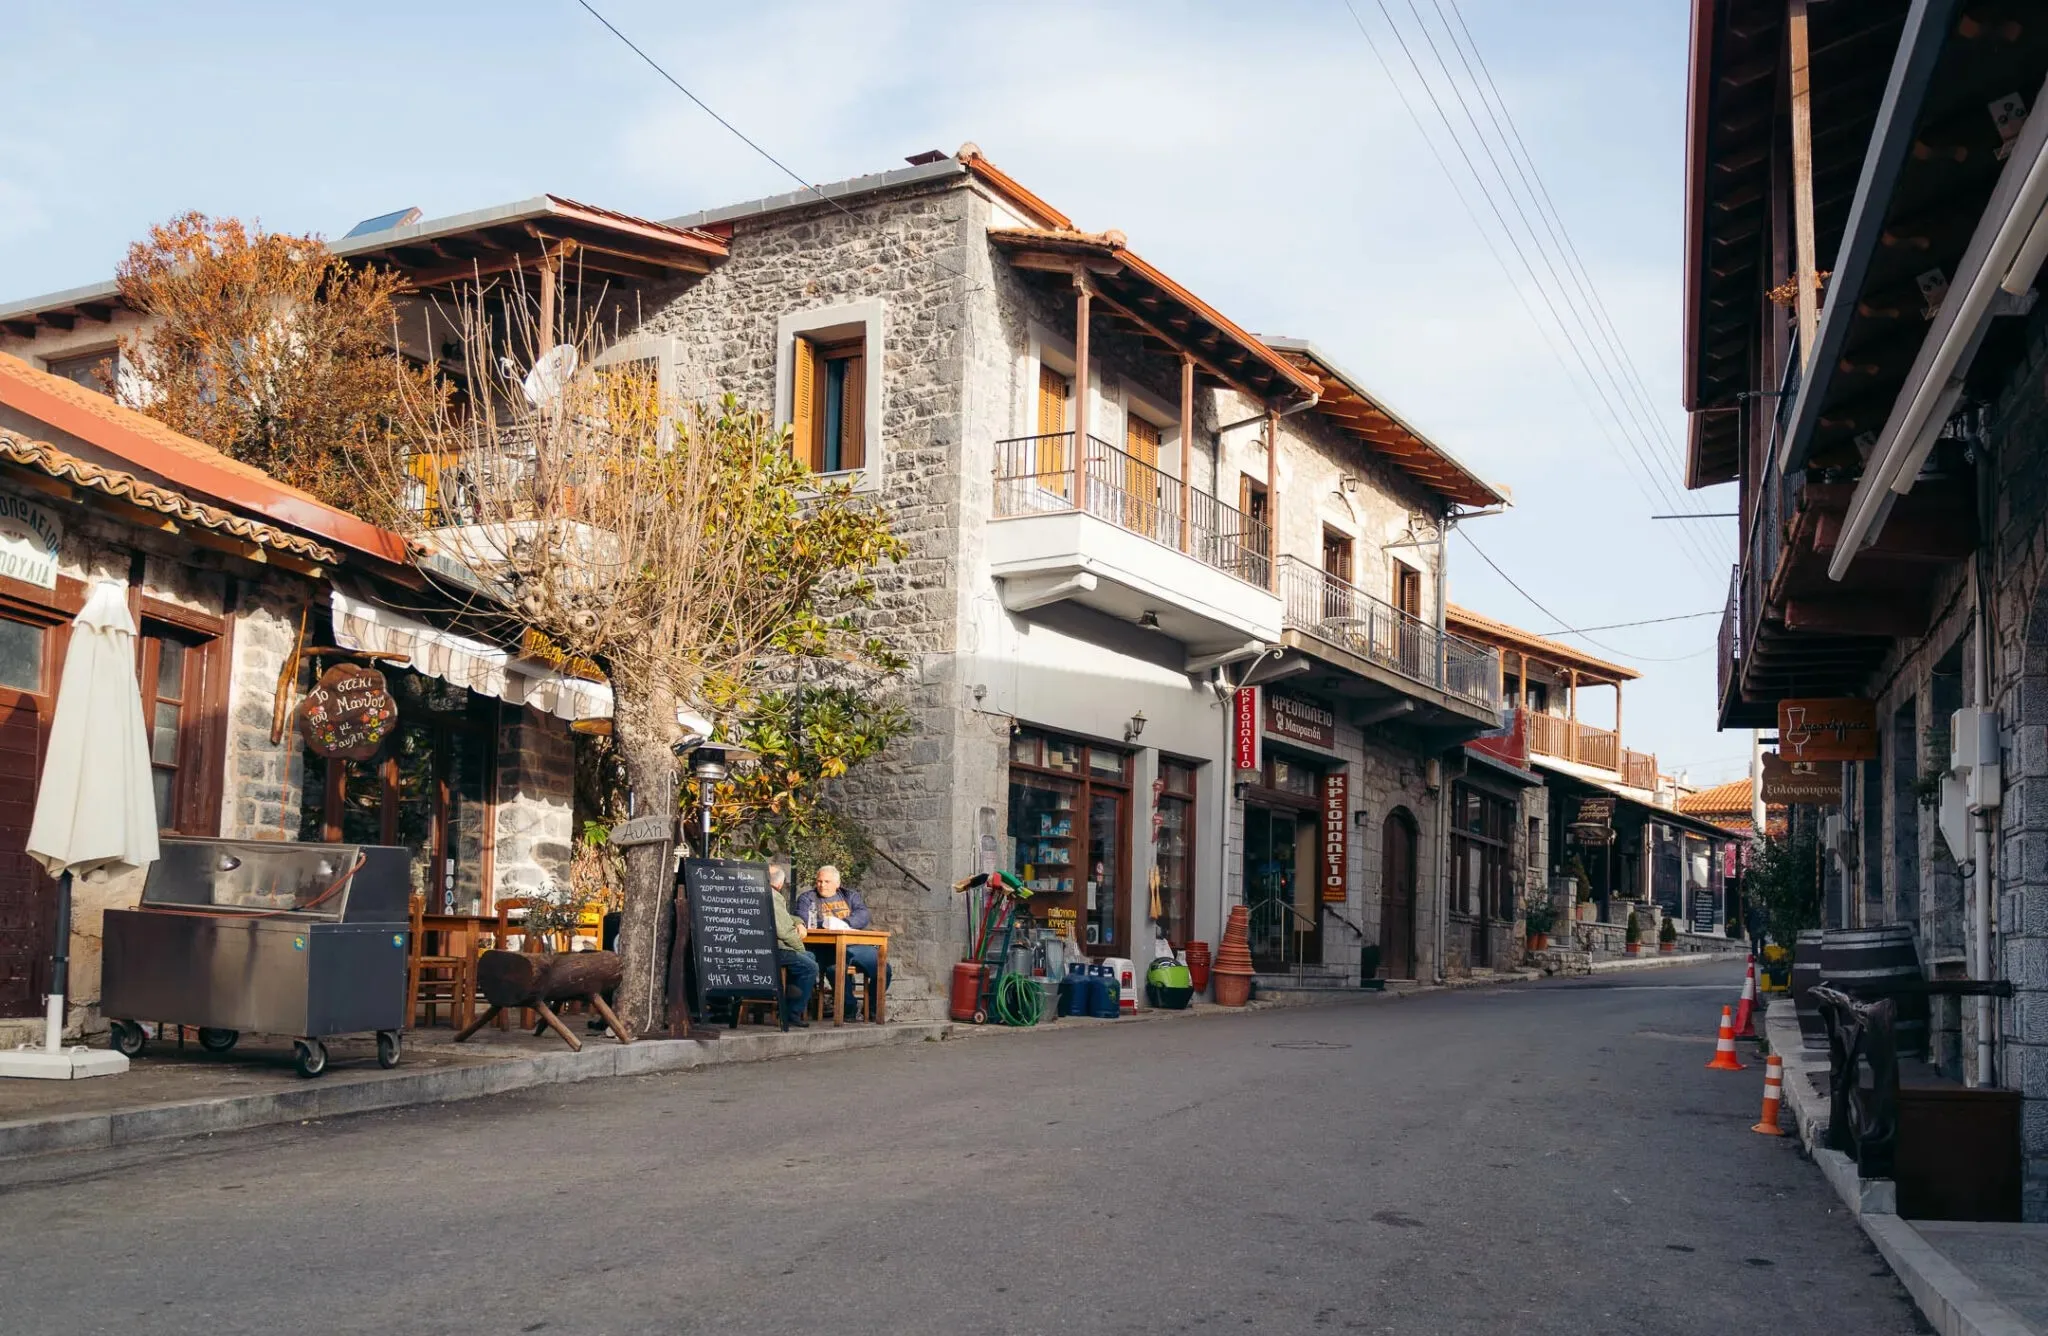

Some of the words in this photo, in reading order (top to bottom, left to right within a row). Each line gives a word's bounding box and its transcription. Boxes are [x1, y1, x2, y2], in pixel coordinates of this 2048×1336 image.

[309, 685, 329, 704] Το
[1271, 694, 1333, 728] ΚΡΕΟΠΩΛΕΙΟ
[1241, 689, 1251, 768] ΚΡΕΟΠΩΛΕΙΟ
[1327, 777, 1344, 886] ΚΡΕΟΠΩΛΕΙΟ
